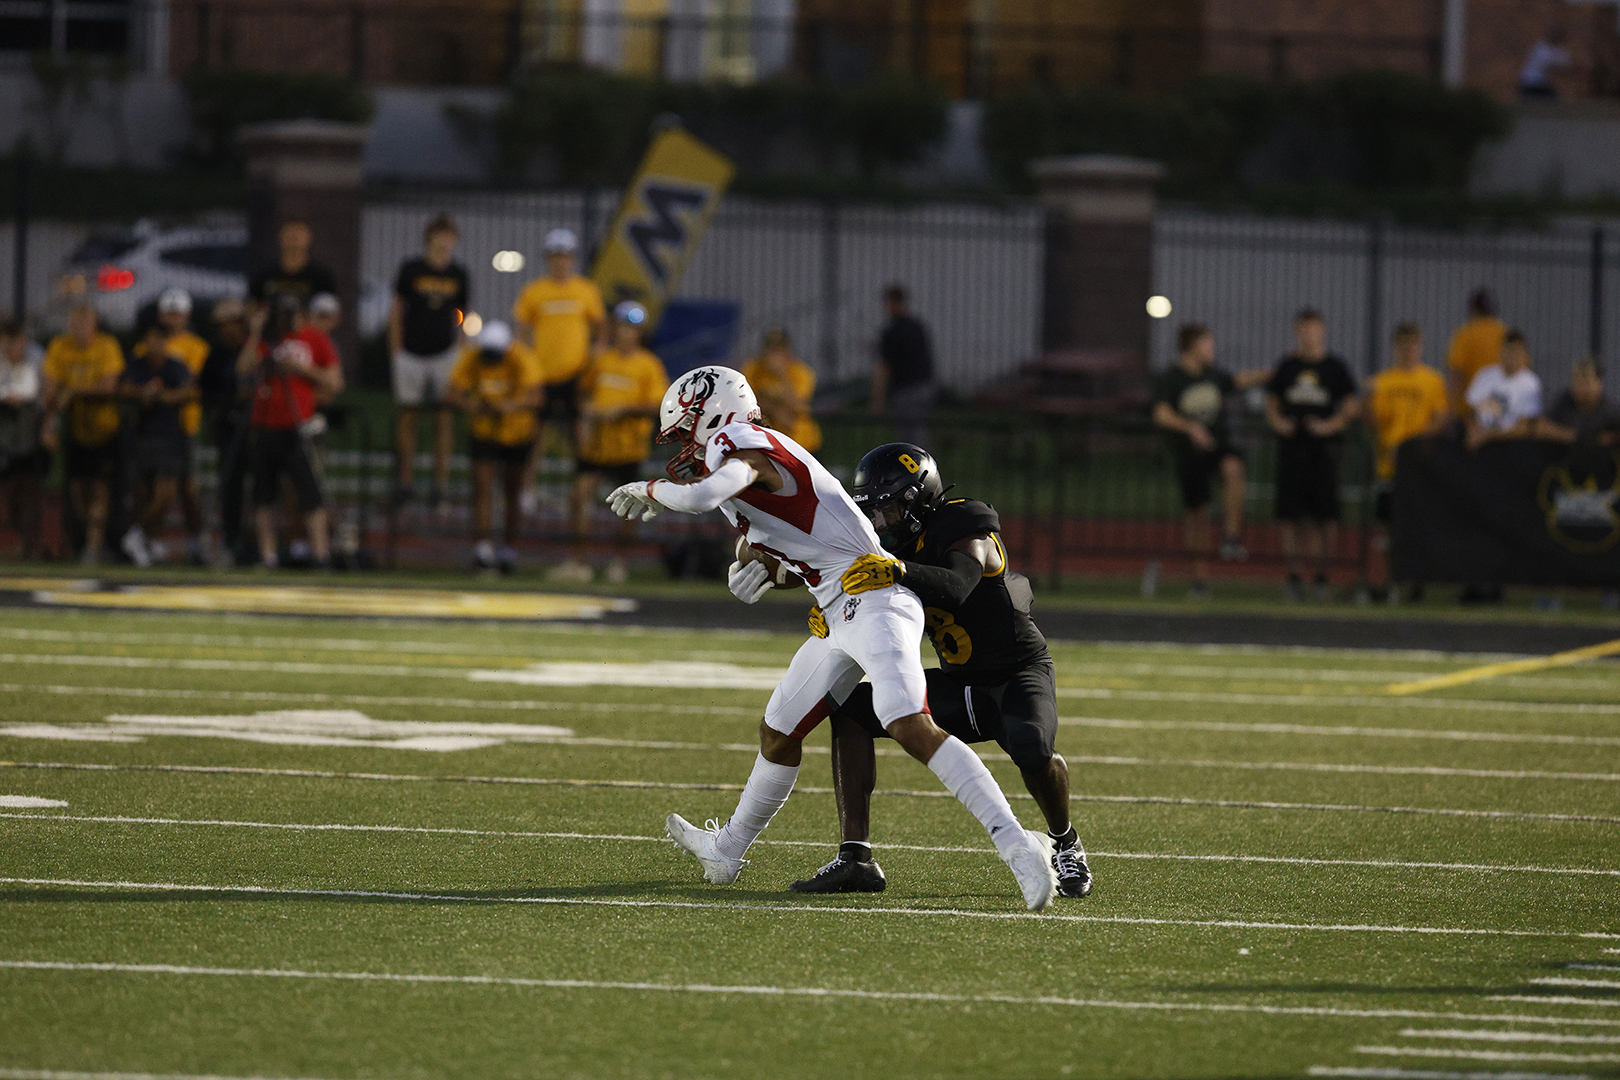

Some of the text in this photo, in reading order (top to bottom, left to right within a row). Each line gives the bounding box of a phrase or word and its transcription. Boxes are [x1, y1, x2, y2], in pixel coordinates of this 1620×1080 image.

[714, 432, 737, 457] 3
[898, 453, 919, 474] 8
[924, 606, 973, 666] 8
